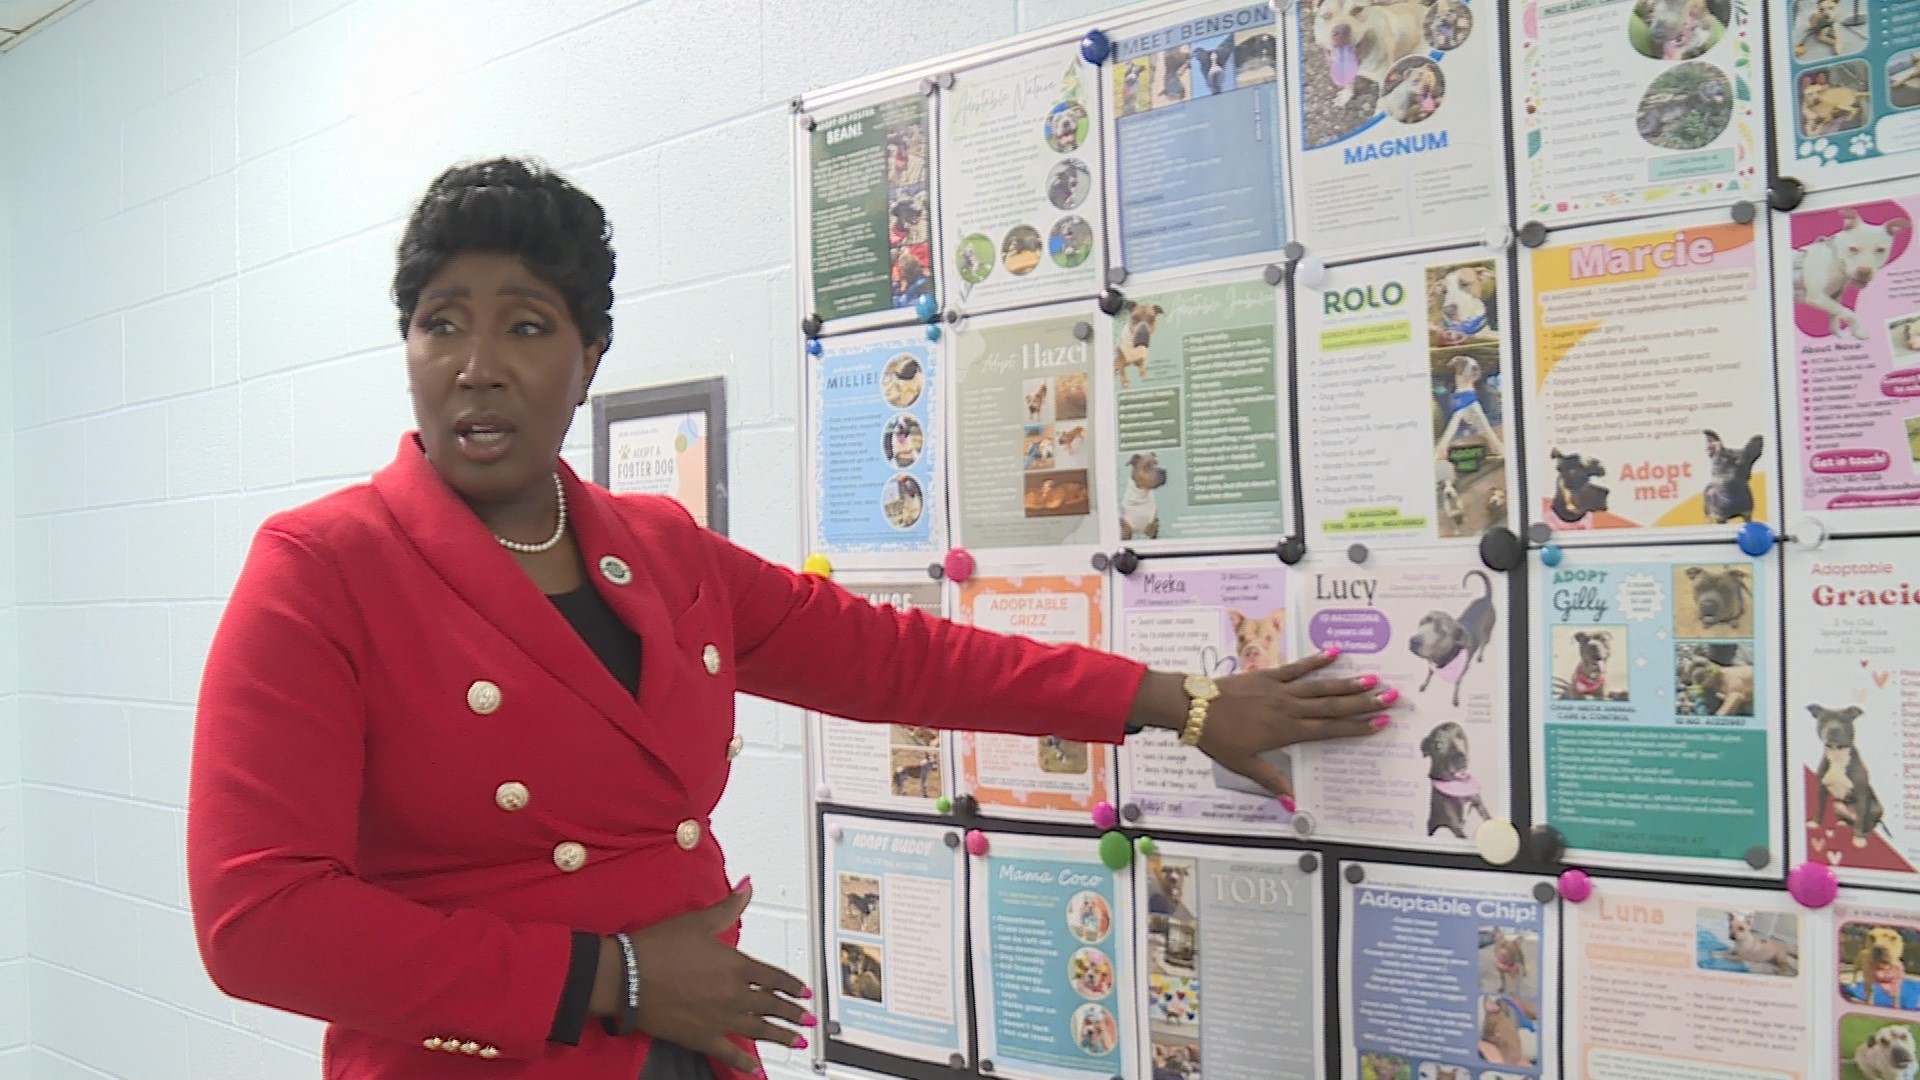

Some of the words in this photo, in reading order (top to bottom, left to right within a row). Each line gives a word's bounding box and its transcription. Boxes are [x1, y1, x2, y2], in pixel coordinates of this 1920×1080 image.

[1180, 8, 1270, 41] BENSON
[825, 122, 863, 146] BEAN!
[1344, 130, 1448, 164] MAGNUM
[1570, 231, 1715, 280] Marcie
[1323, 281, 1404, 314] ROLO
[1023, 342, 1088, 369] Hazel
[826, 371, 880, 389] MILLIE!
[617, 461, 651, 479] FOSTER
[655, 458, 674, 475] DOG
[1619, 460, 1692, 487] Adopt
[1634, 481, 1678, 500] me!
[1552, 569, 1607, 585] ADOPT
[1811, 562, 1894, 576] Adoptable
[1143, 573, 1187, 594] Meeka
[1315, 573, 1377, 606] Lucy
[990, 597, 1068, 611] ADOPTABLE
[1552, 585, 1608, 622] Gilly
[1010, 614, 1048, 627] GRIZZ
[852, 832, 889, 852] ADOPT
[999, 864, 1053, 883] Mama
[1058, 868, 1104, 888] Coco
[1211, 873, 1299, 906] TOBY
[1358, 890, 1472, 917] Adoptable
[1475, 900, 1538, 922] Chip!
[1599, 896, 1665, 925] Luna
